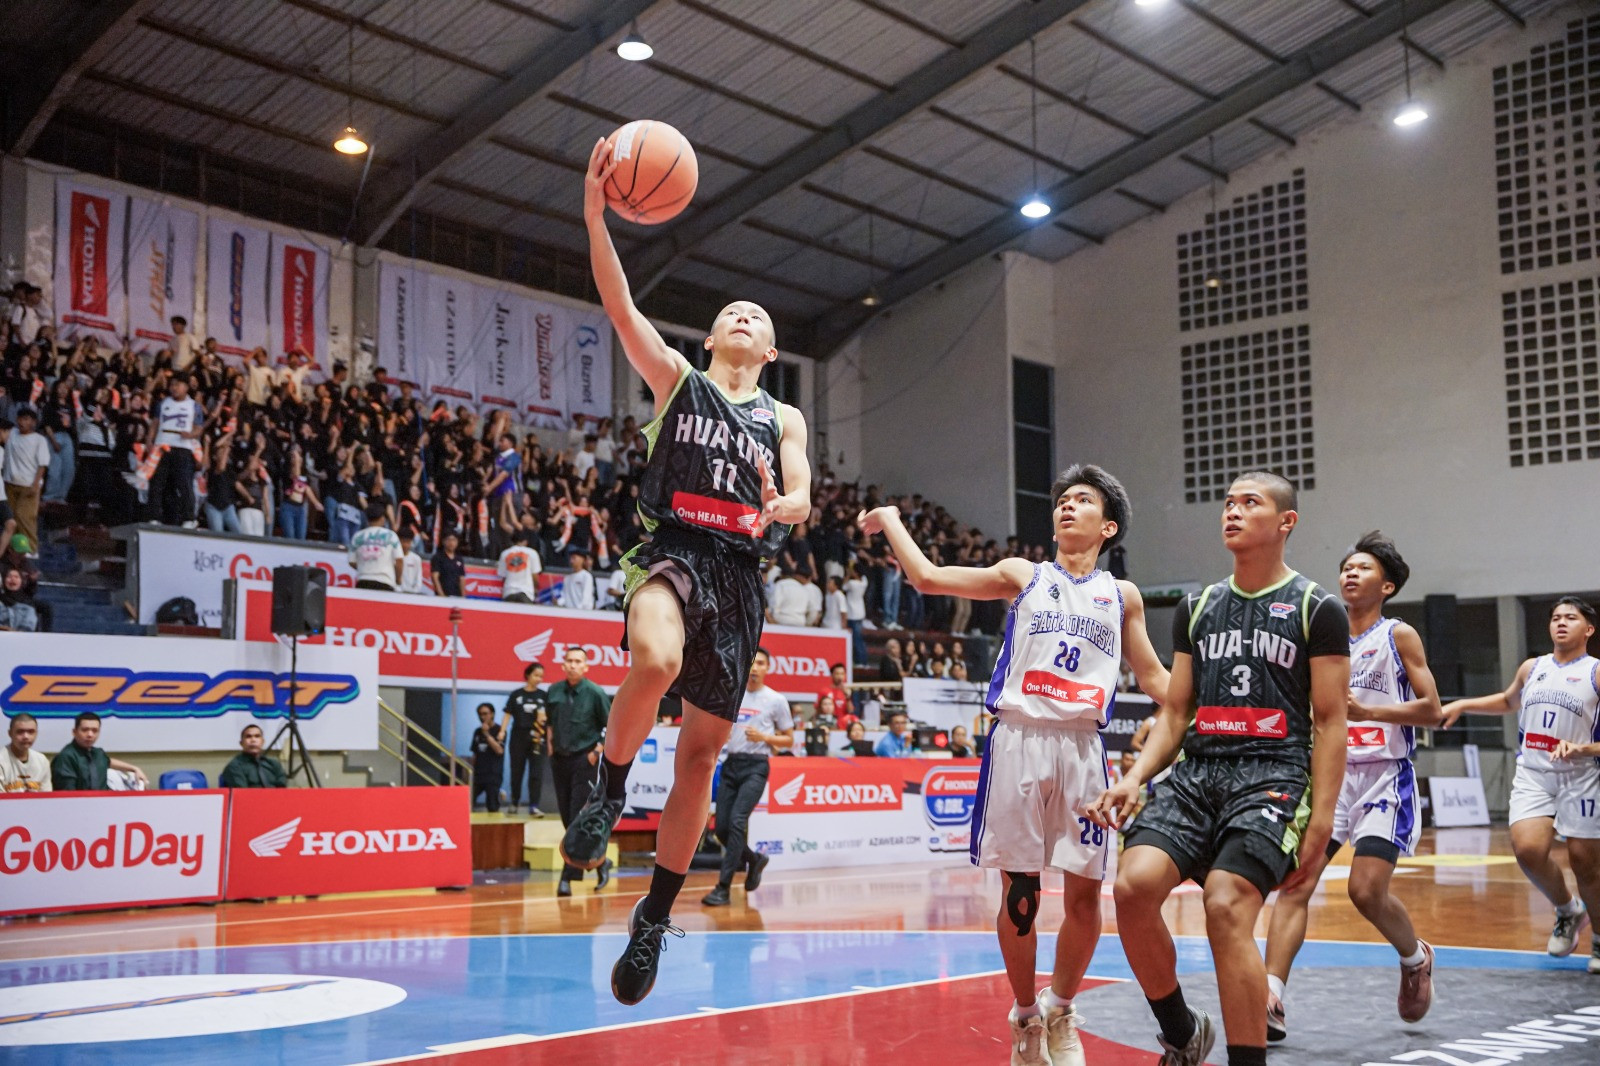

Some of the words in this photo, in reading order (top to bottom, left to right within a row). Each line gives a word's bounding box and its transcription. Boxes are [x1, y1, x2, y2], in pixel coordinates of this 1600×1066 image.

[580, 354, 593, 404] Biznet
[712, 458, 738, 493] 11
[677, 507, 696, 520] One
[697, 511, 728, 527] HEART.
[478, 585, 503, 593] HON
[324, 626, 472, 658] HONDA
[552, 642, 631, 667] HON
[1053, 640, 1081, 673] 28
[767, 655, 831, 677] ONDA
[1026, 682, 1040, 692] One
[1041, 684, 1068, 700] HEART.
[1230, 664, 1251, 697] 3
[1200, 721, 1215, 731] One
[1216, 720, 1247, 732] HEART.
[1543, 710, 1556, 729] 17
[804, 785, 898, 805] HONDA
[944, 780, 979, 791] HOND
[1580, 799, 1595, 818] 17
[300, 827, 457, 856] HONDA
[1078, 816, 1103, 847] 28
